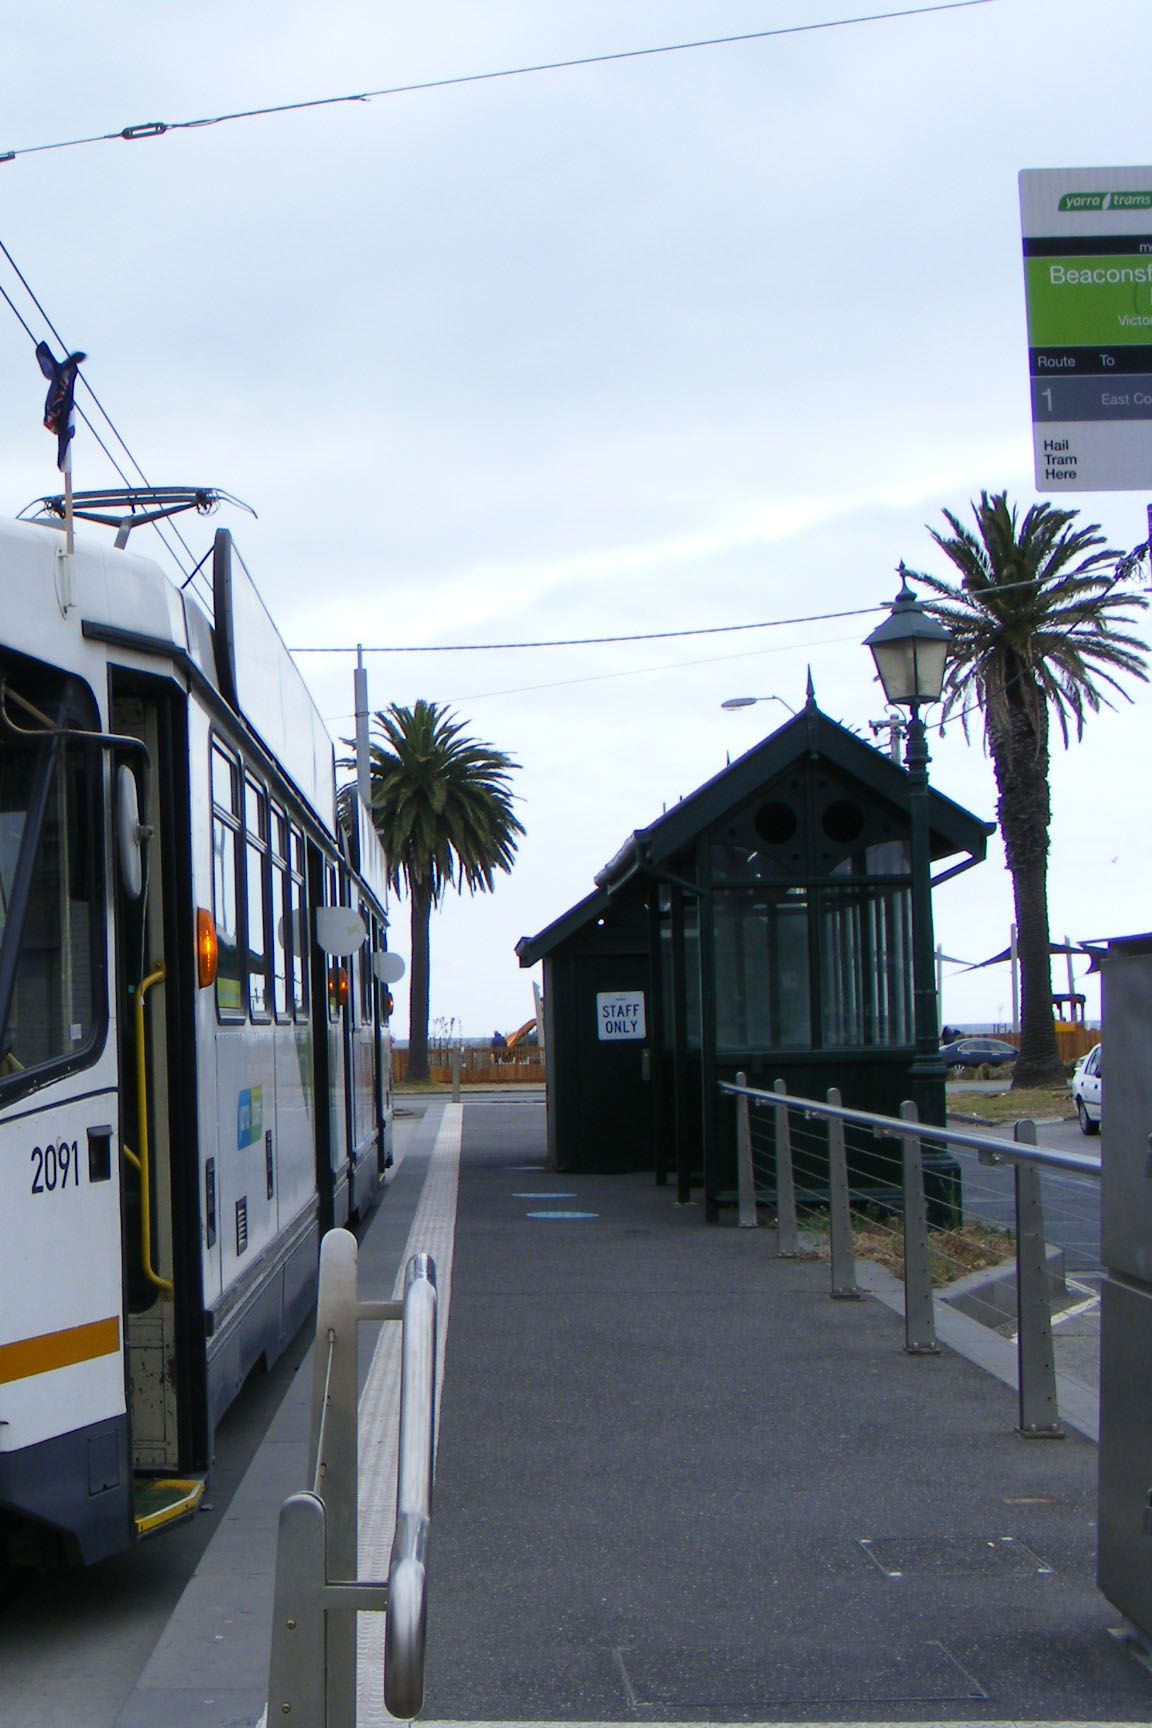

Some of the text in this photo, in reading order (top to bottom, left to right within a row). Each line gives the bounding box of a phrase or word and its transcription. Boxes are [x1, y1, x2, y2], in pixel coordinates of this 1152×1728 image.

[1066, 195, 1151, 209] yarra trams
[1037, 354, 1115, 368] Route To
[1041, 388, 1052, 412] 1
[1102, 393, 1129, 406] East
[1044, 440, 1069, 451] Hail
[1045, 454, 1077, 465] Tram
[1045, 468, 1077, 480] Here
[603, 1004, 639, 1018] STAFF
[605, 1020, 638, 1034] ONLY
[31, 1140, 79, 1194] 2091
